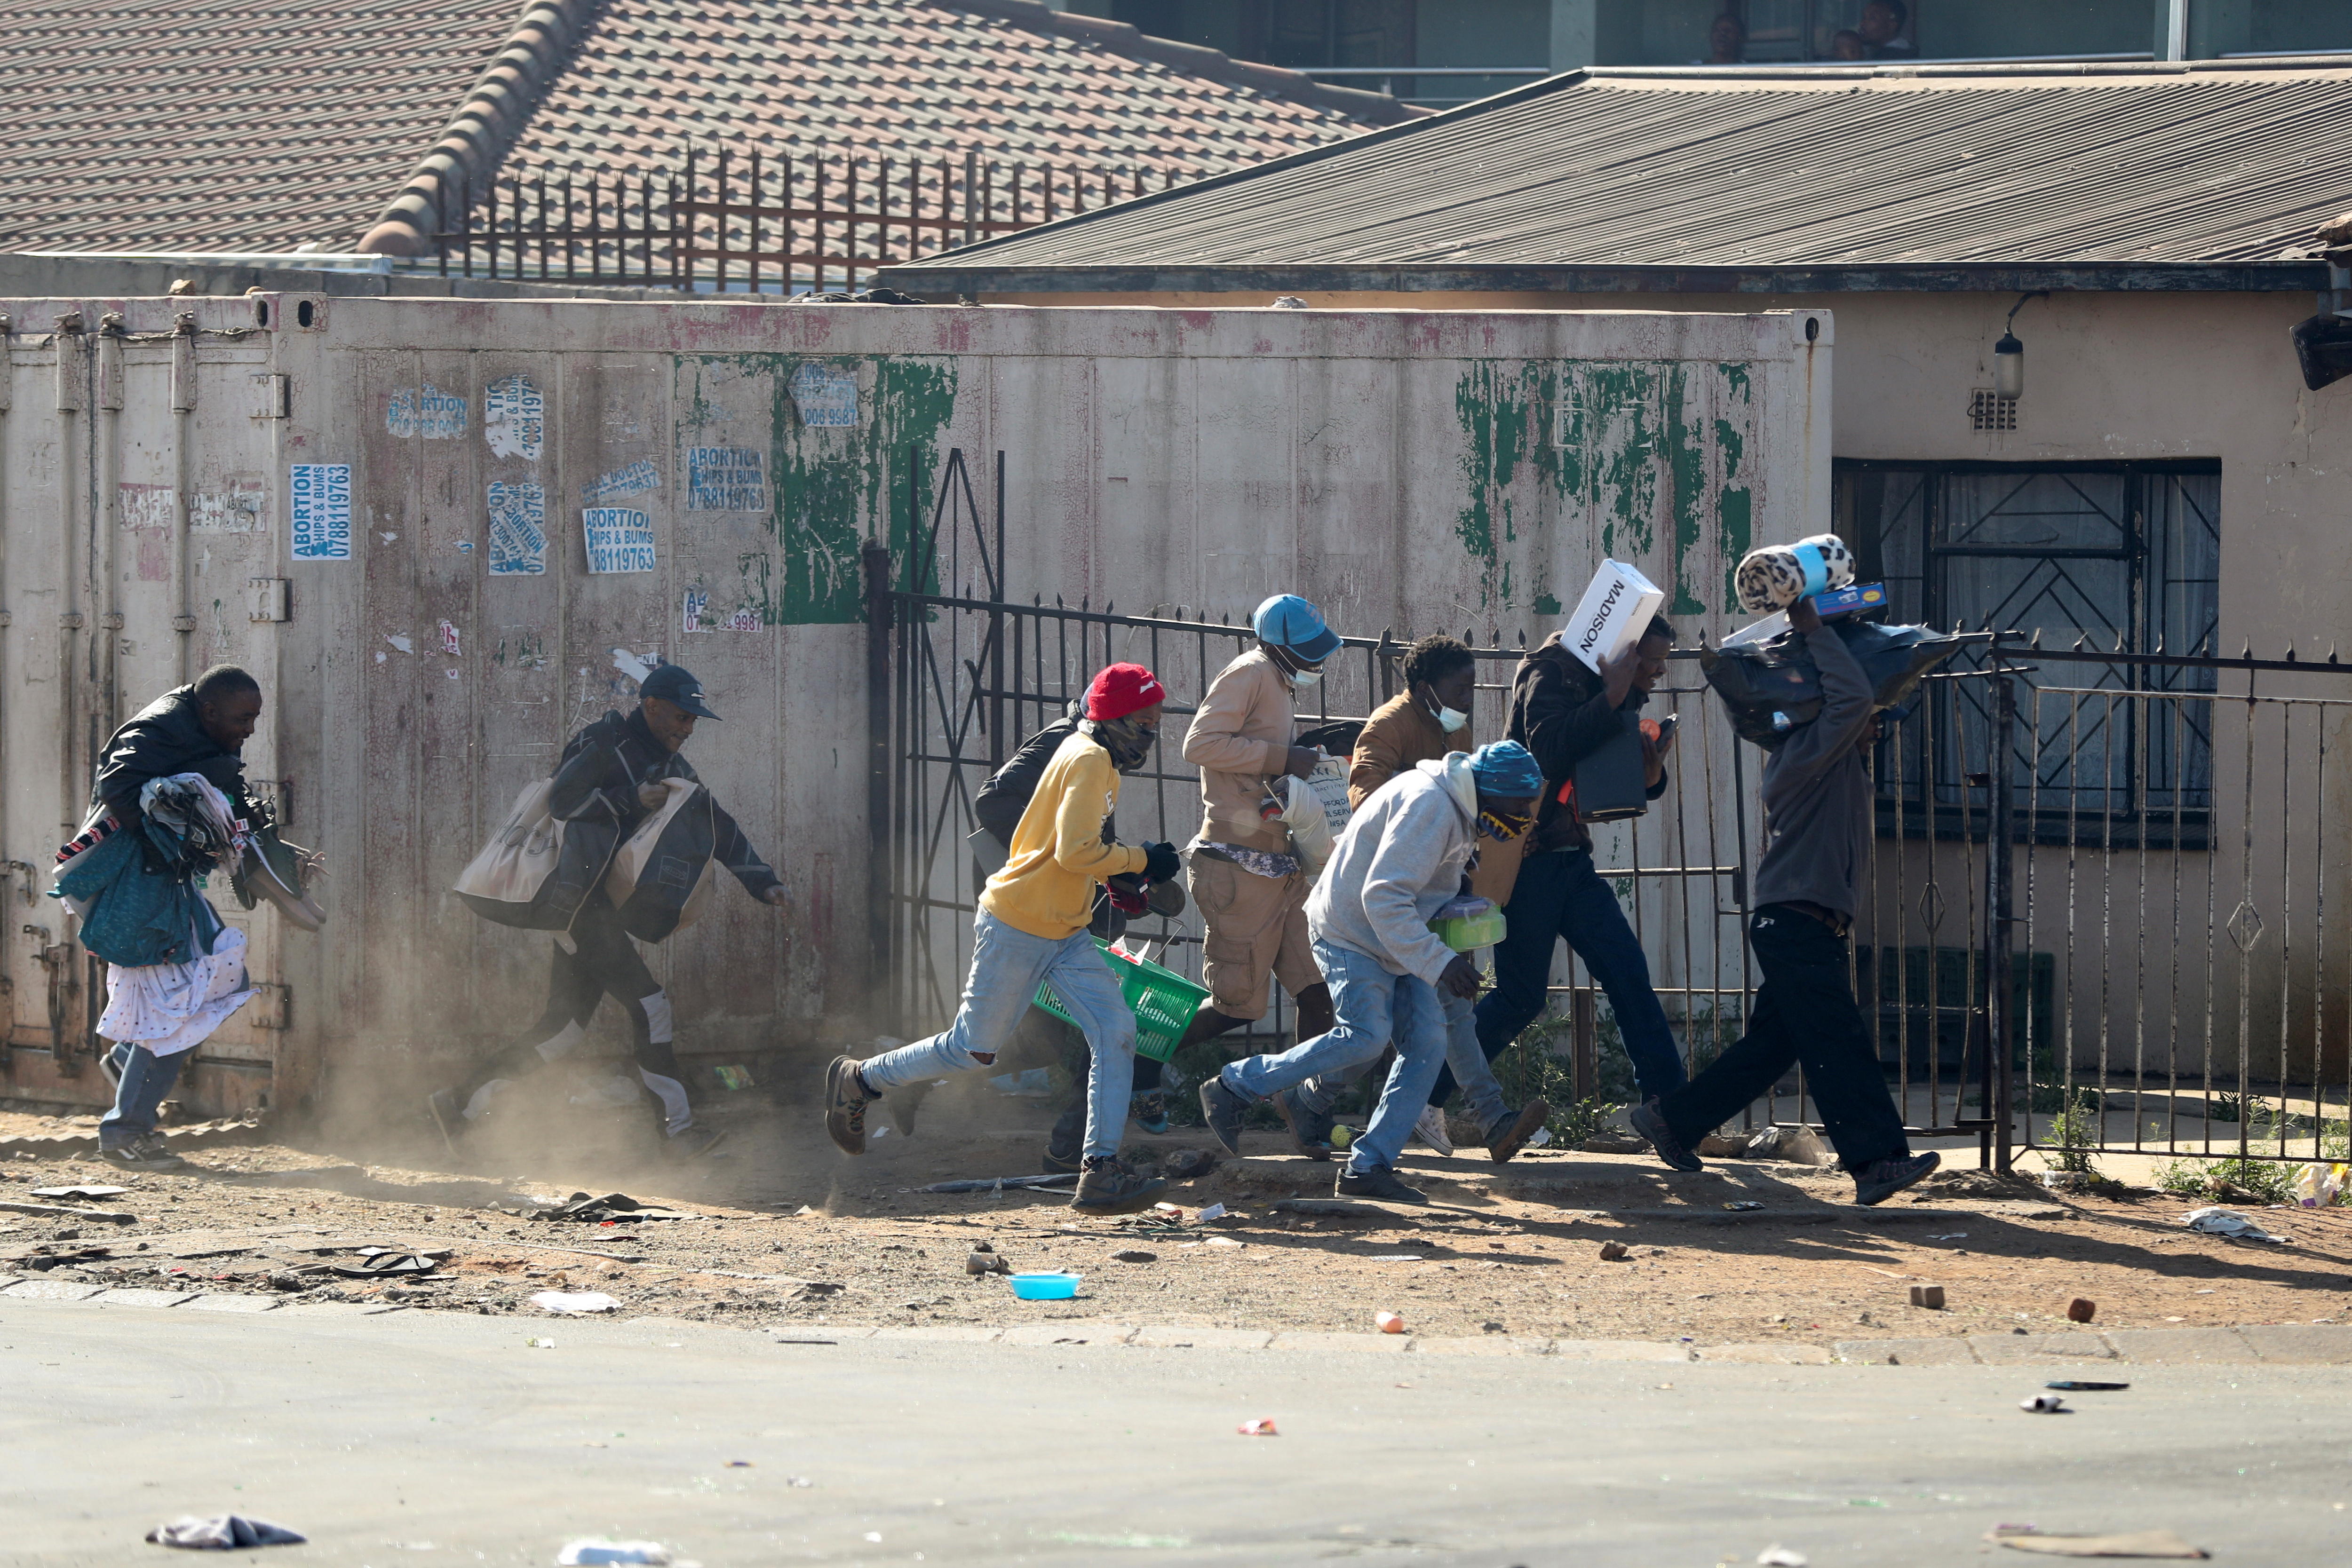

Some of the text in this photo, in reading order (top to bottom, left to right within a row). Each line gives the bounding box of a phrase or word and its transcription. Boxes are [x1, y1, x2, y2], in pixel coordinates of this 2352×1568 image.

[805, 408, 825, 425] 006
[313, 467, 325, 499] BUMS
[727, 470, 733, 484] &
[737, 469, 763, 485] BUMS
[294, 466, 310, 557] ABORTION
[327, 466, 349, 557] 0788119763
[688, 487, 765, 510] 0788119763
[313, 515, 325, 541] HIPS
[615, 530, 622, 545] &
[624, 530, 654, 545] BUMS
[1580, 579, 1626, 654] MADISON
